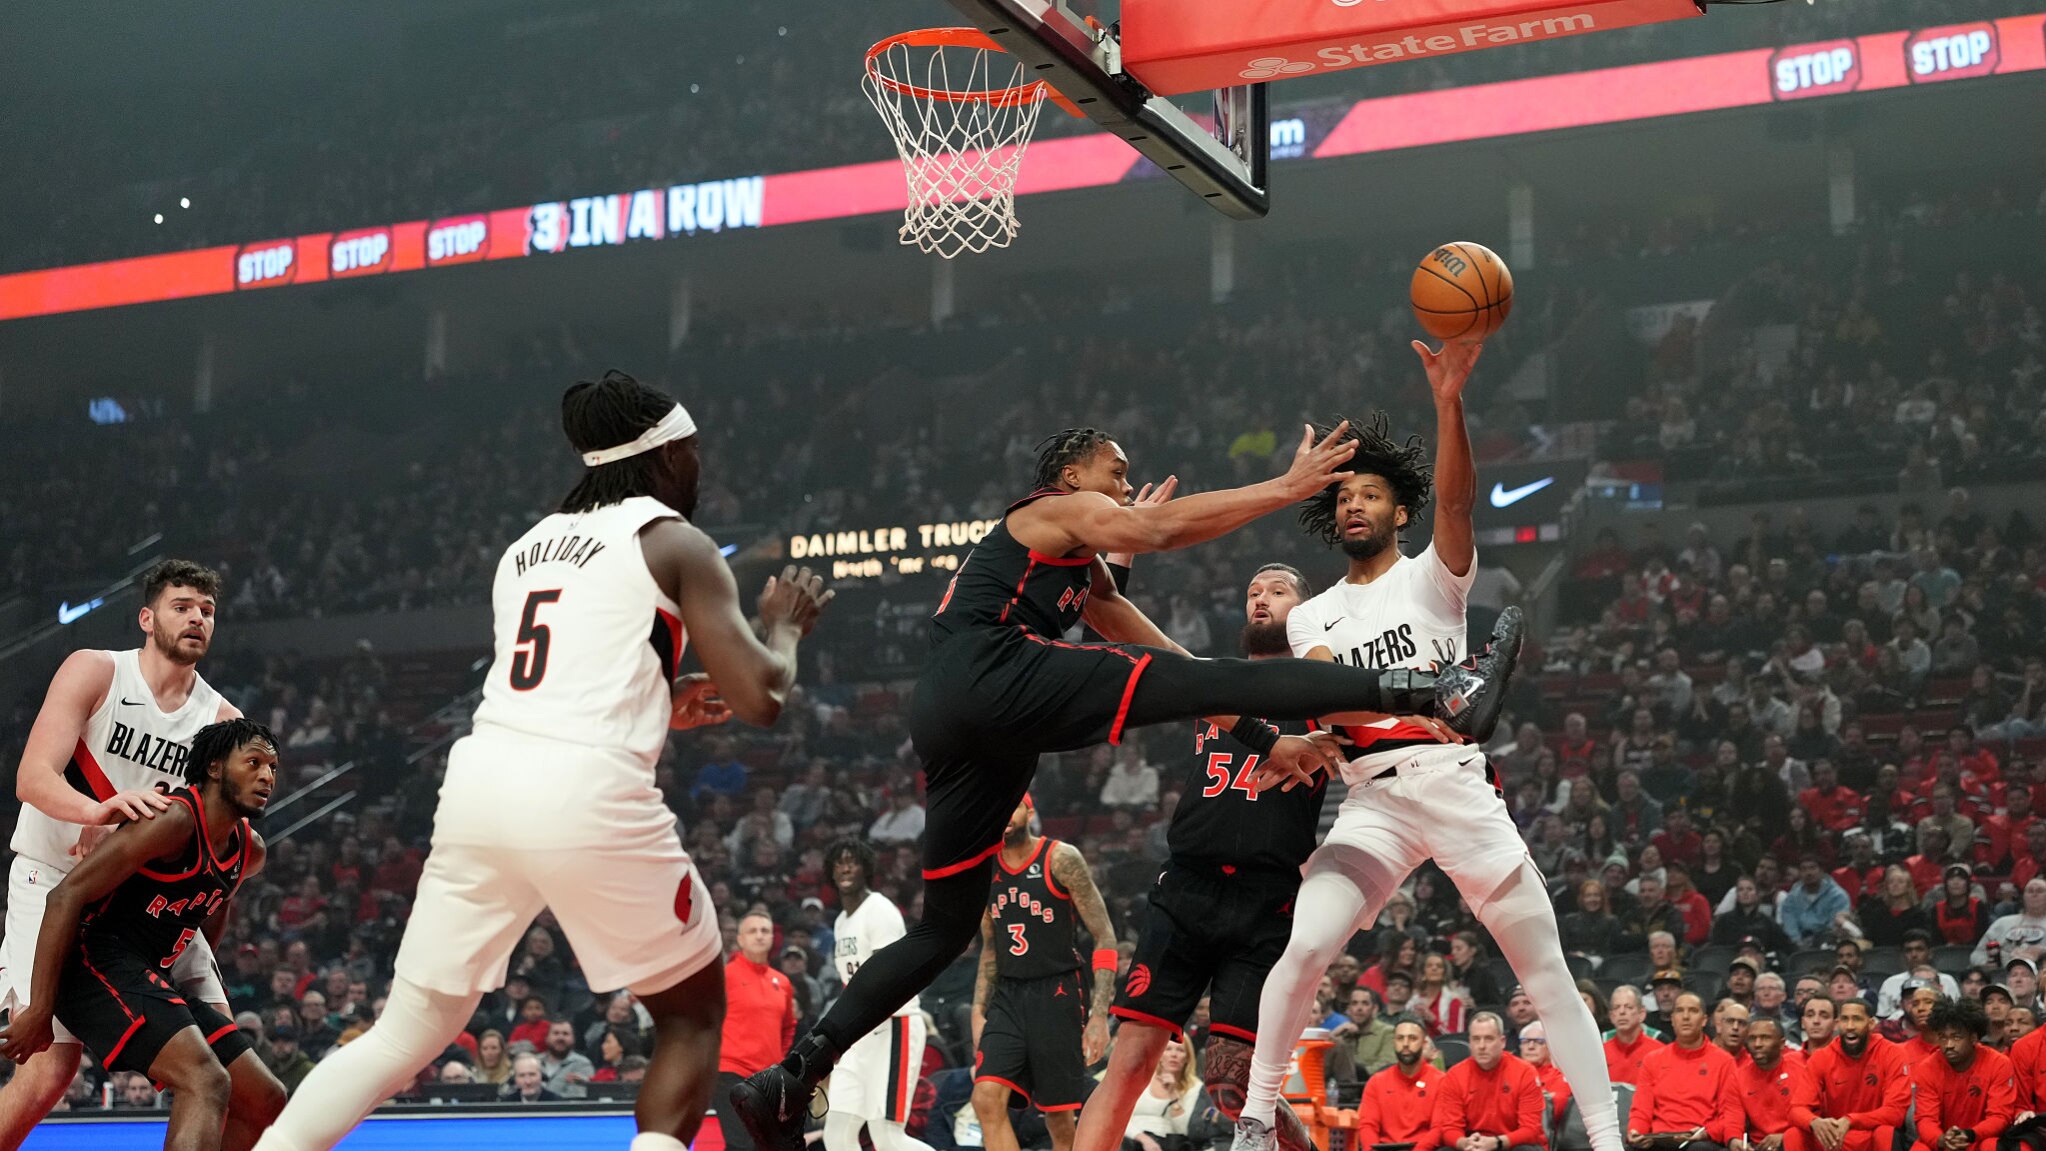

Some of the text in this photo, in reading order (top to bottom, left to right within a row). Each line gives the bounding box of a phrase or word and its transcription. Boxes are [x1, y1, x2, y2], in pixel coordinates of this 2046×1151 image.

[1776, 47, 1853, 93] STOP
[1912, 29, 1991, 75] STOP
[530, 176, 763, 250] 3 IN A ROW
[331, 232, 389, 273] STOP
[428, 220, 486, 261] STOP
[238, 245, 293, 284] STOP
[516, 535, 606, 578] HOLIDAY
[791, 527, 907, 559] DAIMLER
[510, 588, 563, 691] 5
[106, 721, 190, 778] BLAZER
[1203, 752, 1260, 801] 54
[991, 887, 1054, 923] APTORS
[160, 927, 197, 969] 5
[1007, 923, 1029, 956] 3
